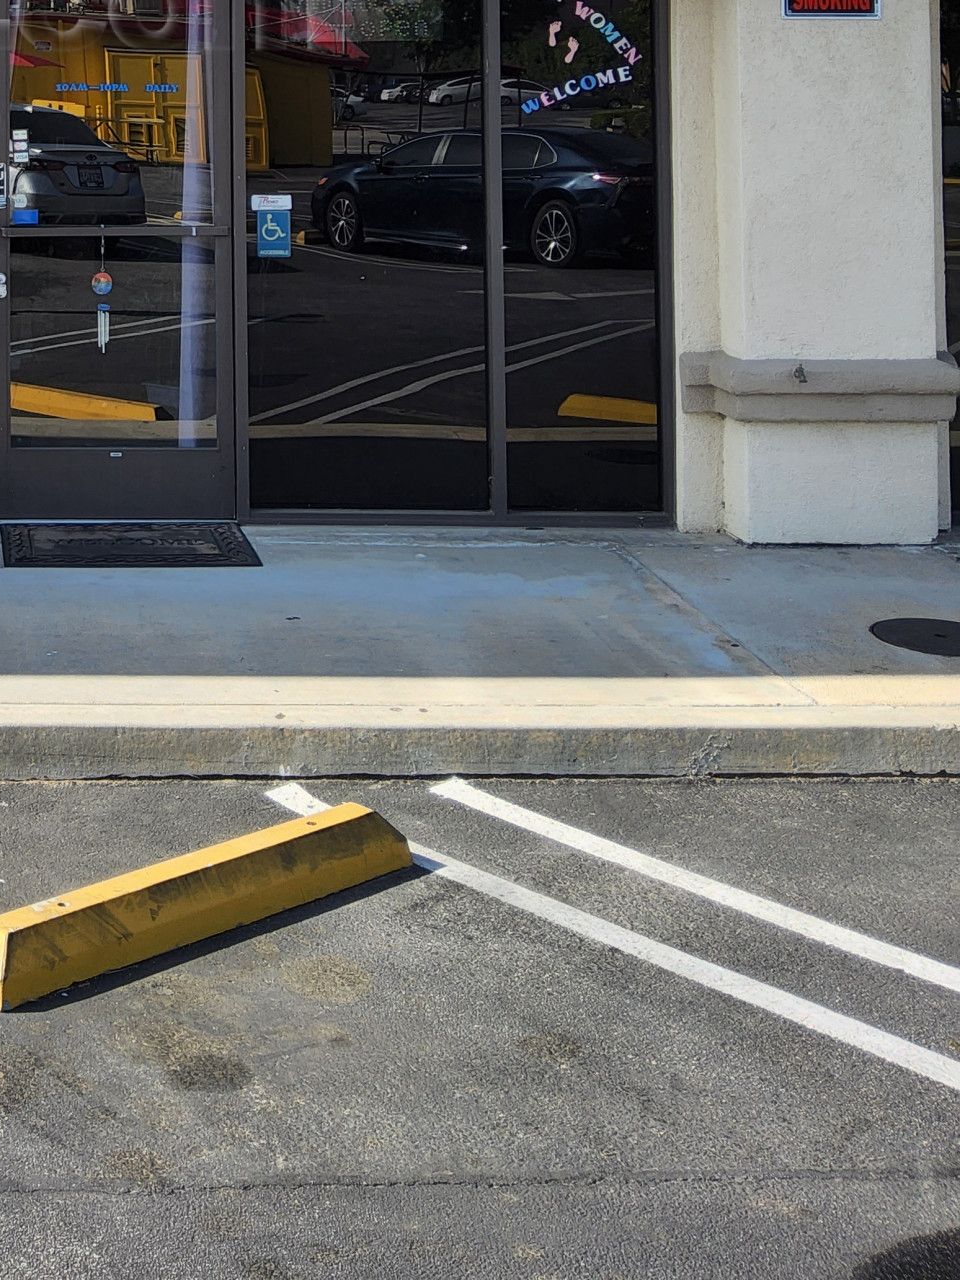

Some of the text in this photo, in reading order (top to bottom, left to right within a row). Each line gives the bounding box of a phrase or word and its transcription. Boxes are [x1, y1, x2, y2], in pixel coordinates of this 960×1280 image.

[574, 0, 643, 66] WOMEN
[145, 83, 179, 93] DAILY
[520, 66, 632, 115] WELCOME
